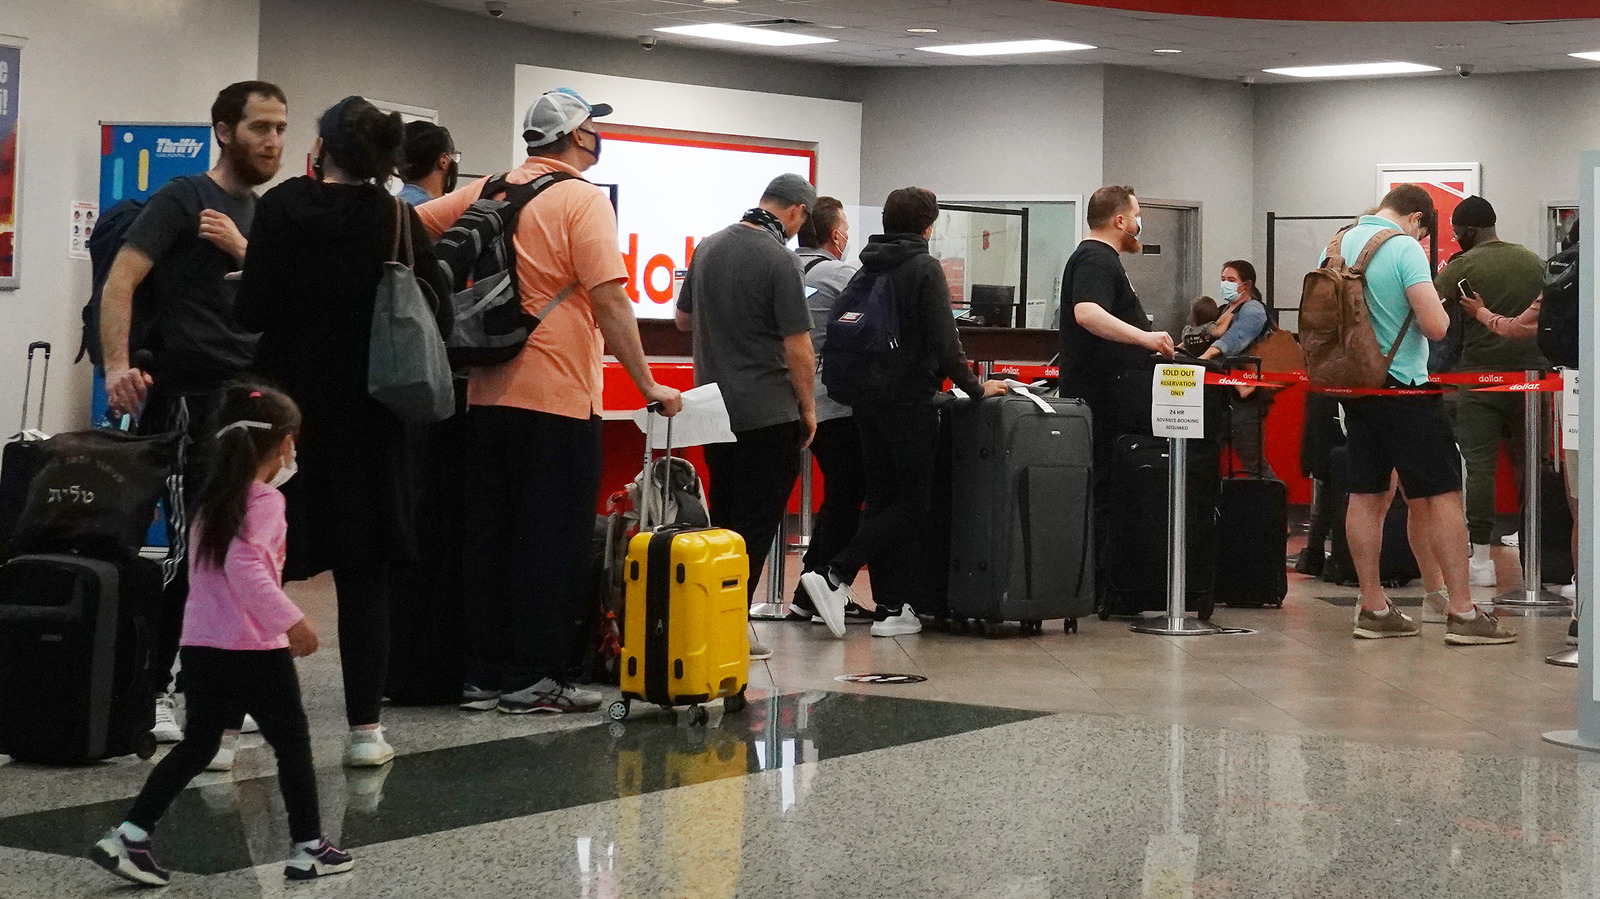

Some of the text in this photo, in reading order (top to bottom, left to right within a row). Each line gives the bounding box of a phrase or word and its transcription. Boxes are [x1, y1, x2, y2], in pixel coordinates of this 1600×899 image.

[156, 138, 204, 158] Thrifty
[1162, 369, 1179, 377] SOLD
[48, 485, 95, 503] טלית
